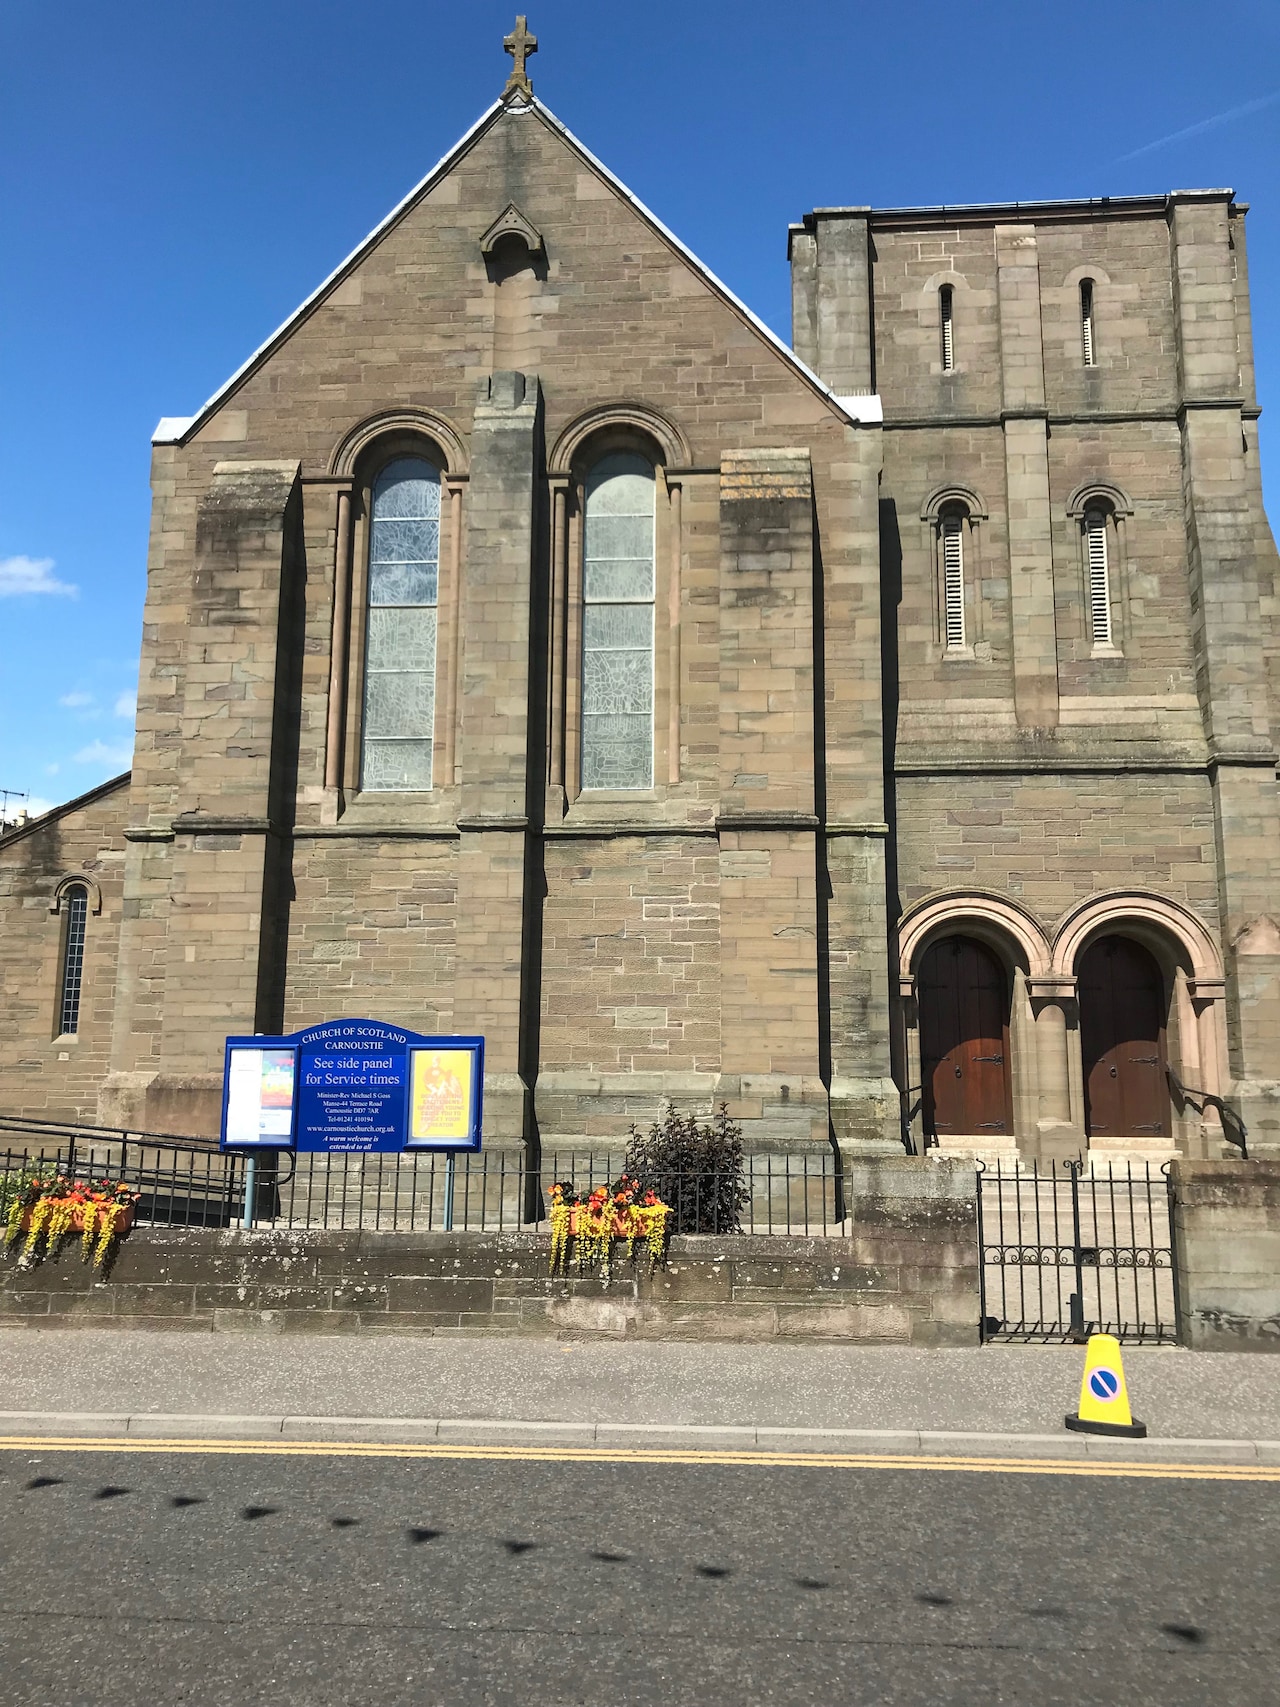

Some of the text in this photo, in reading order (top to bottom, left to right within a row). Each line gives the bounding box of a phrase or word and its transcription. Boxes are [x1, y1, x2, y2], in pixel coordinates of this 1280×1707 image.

[302, 1027, 407, 1044] CHURCH OF SCOTLAND
[325, 1041, 384, 1050] CARNOUSTIE
[314, 1057, 393, 1072] See side panel
[306, 1073, 400, 1085] for Service times
[306, 1125, 395, 1134] www.carnoustiechurch.org.uk
